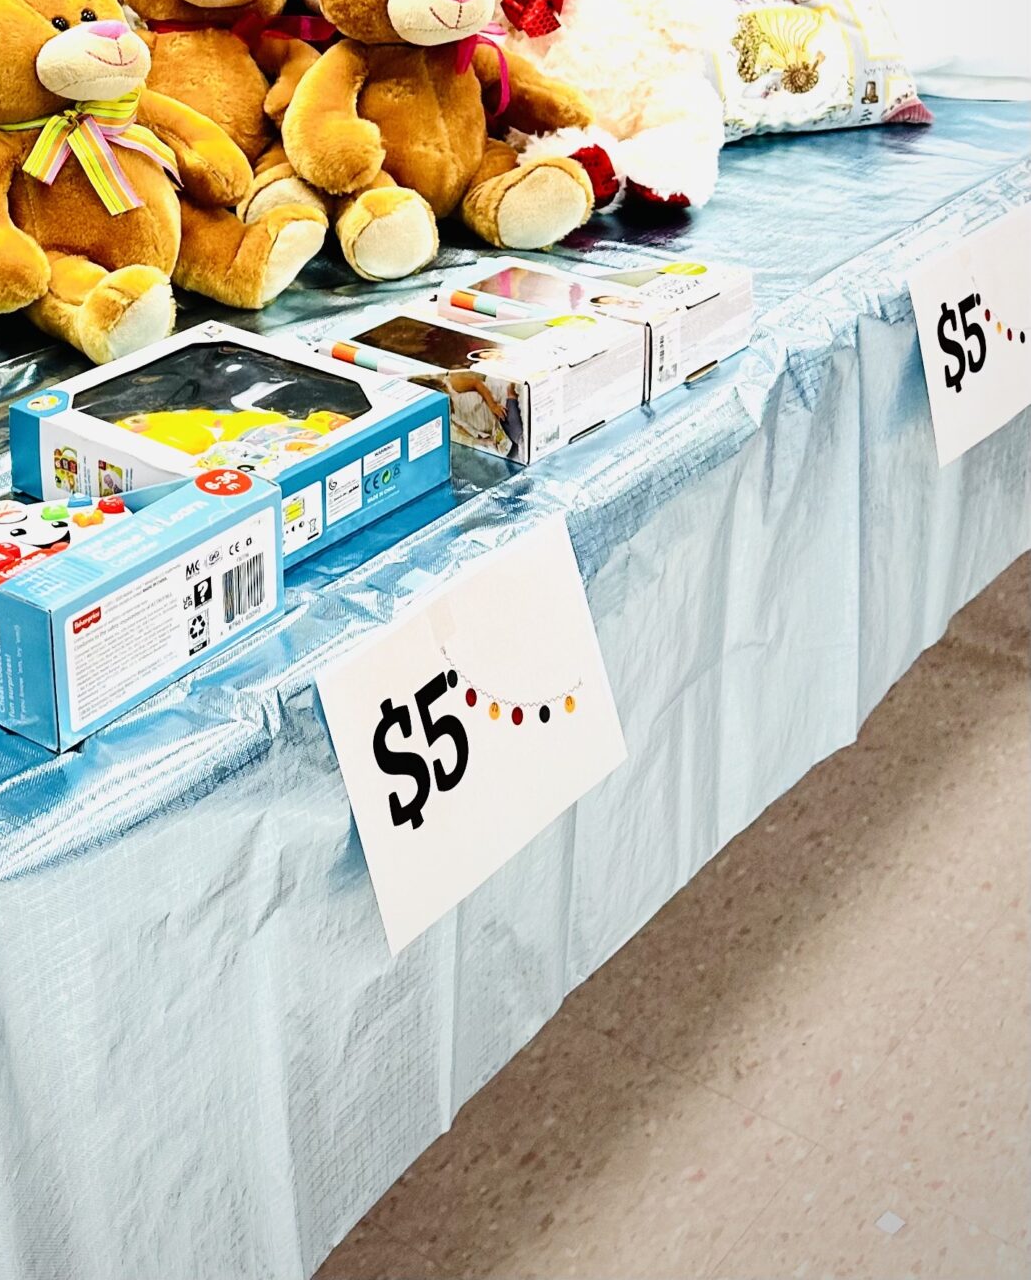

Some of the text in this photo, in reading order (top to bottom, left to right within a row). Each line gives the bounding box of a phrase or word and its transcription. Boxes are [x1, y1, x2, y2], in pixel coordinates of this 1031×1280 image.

[937, 293, 986, 393] $5
[205, 472, 239, 491] 6-36
[5, 653, 14, 700] surprises!
[373, 671, 469, 830] $5
